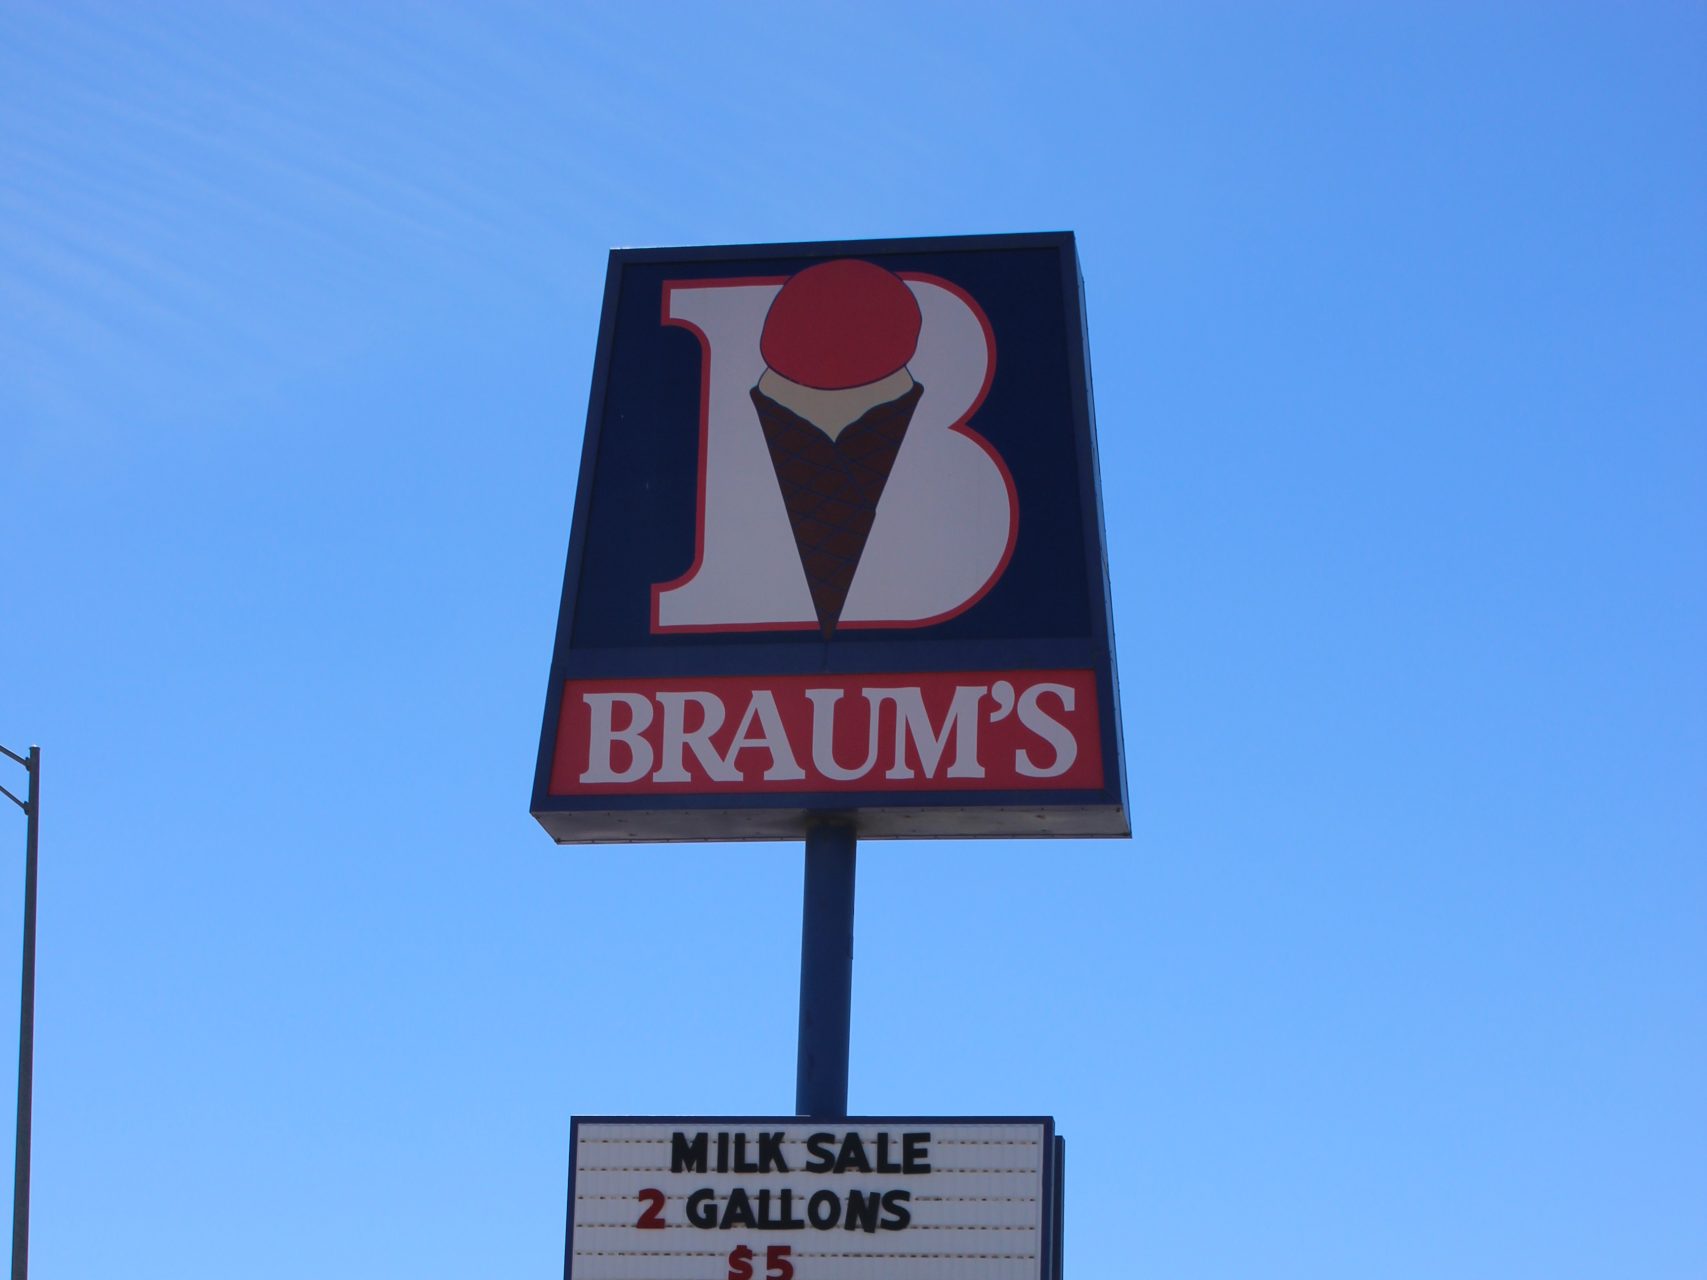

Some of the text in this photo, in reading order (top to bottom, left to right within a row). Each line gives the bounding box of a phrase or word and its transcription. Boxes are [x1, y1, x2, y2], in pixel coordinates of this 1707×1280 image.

[579, 680, 1078, 784] BRAUM'S
[670, 1131, 932, 1175] MILK SALE
[636, 1187, 912, 1234] 2 GALLONS
